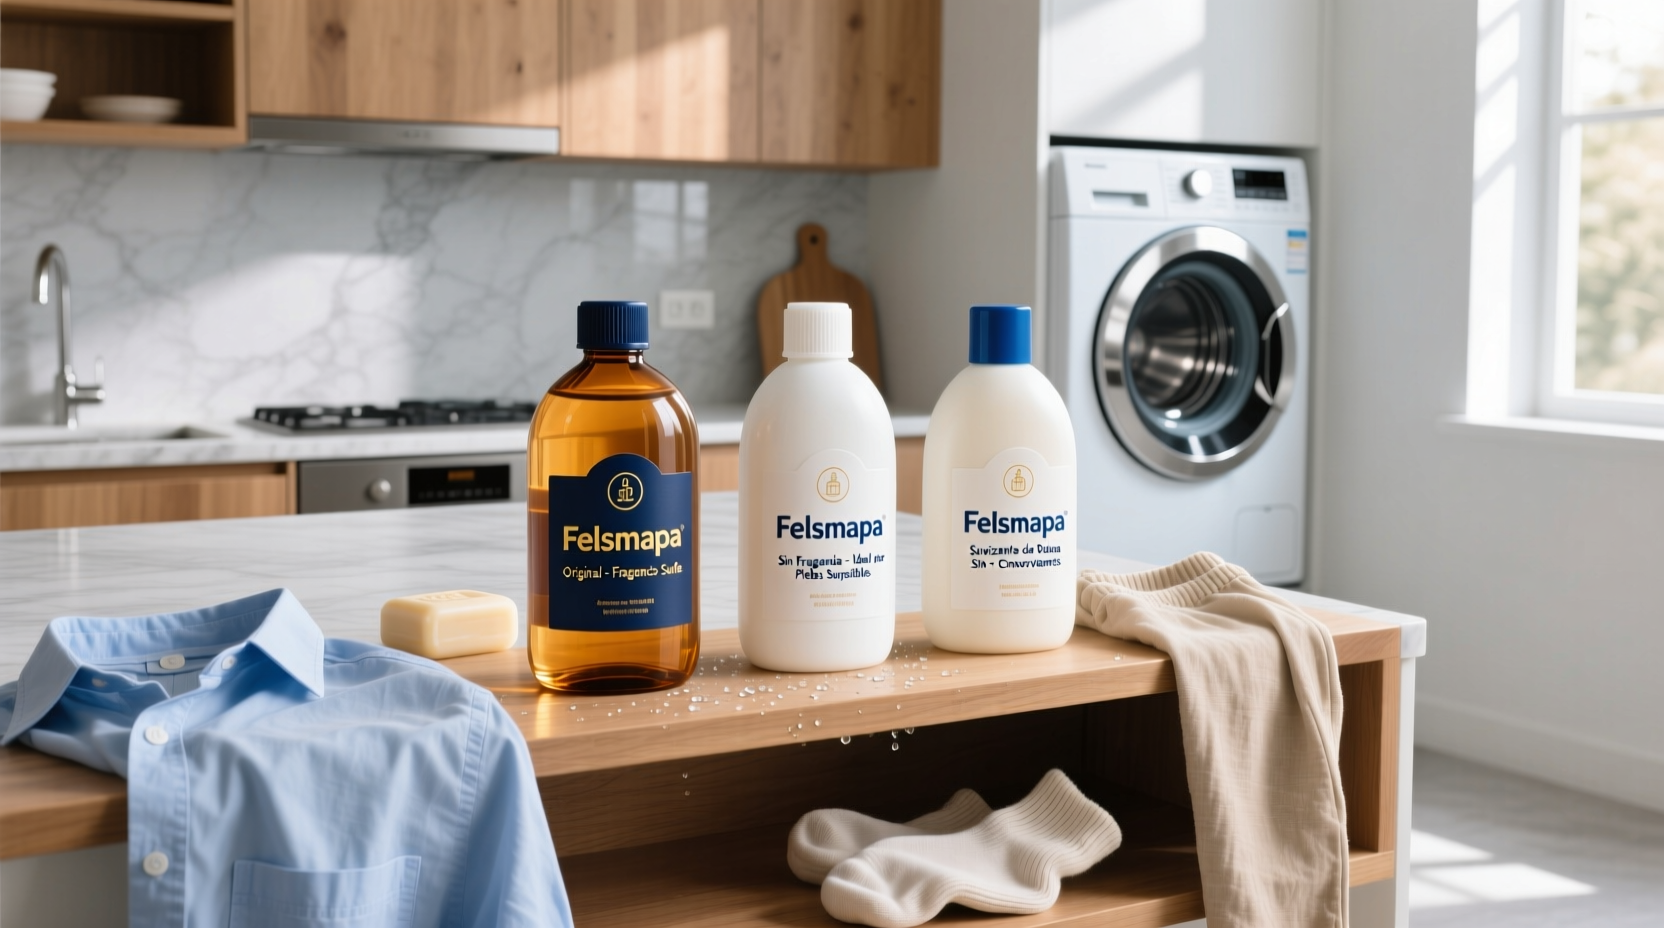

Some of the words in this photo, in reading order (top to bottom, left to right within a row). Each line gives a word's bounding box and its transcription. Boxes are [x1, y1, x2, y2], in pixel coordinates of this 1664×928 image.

[777, 515, 883, 544] Felsmapa
[964, 510, 1065, 538] Felsmapa
[563, 525, 682, 557] Felsmapa
[563, 565, 602, 582] Original
